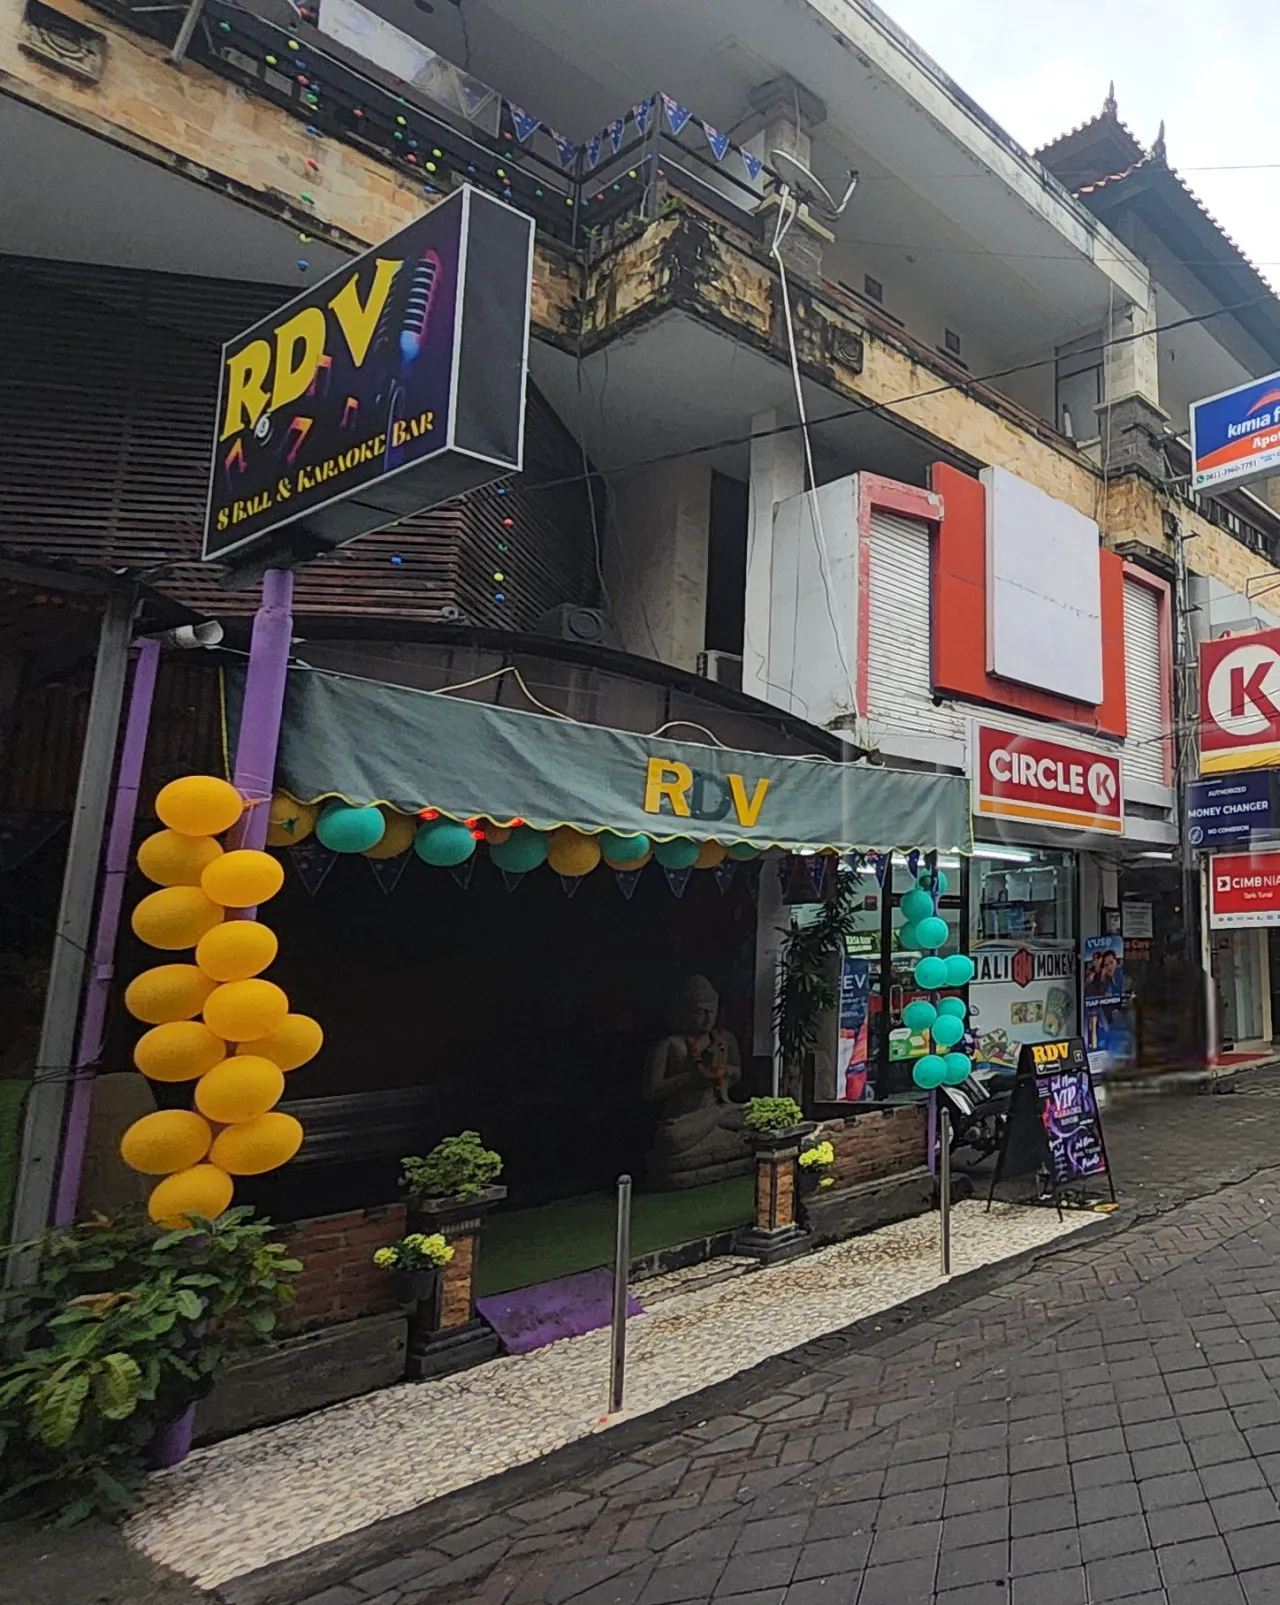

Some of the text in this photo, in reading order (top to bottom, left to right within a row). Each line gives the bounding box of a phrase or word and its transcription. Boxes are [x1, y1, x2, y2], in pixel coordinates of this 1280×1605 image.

[220, 258, 404, 442] RDV
[1227, 413, 1270, 439] kimia
[276, 477, 292, 502] &
[989, 749, 1115, 805] CIRCLE K
[644, 757, 770, 828] RDV
[1188, 800, 1269, 818] MONEY CHANGER
[1232, 876, 1262, 889] CIMB
[1037, 953, 1074, 977] MONEY
[1032, 1042, 1069, 1063] RDV
[1054, 1086, 1076, 1111] VIP
